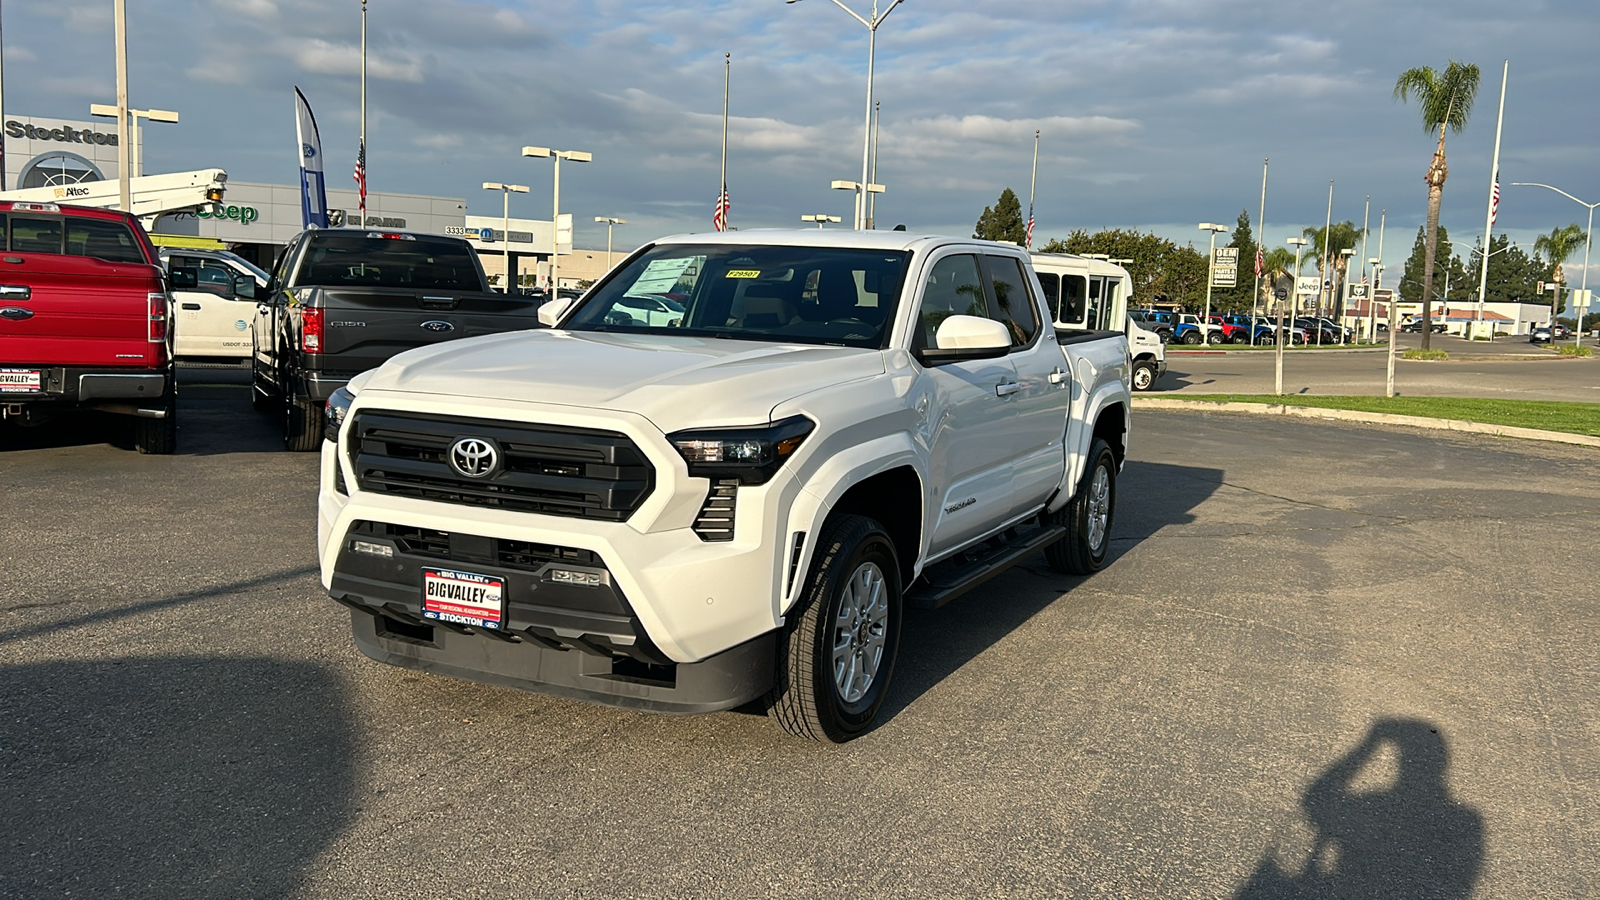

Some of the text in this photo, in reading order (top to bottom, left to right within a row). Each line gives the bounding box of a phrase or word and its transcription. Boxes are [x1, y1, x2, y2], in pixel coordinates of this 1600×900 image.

[5, 120, 119, 146] Stockton
[66, 187, 90, 197] Altec
[348, 215, 406, 228] RAM
[446, 227, 465, 236] 3333
[1216, 249, 1236, 257] OEM
[1299, 282, 1319, 292] Jeep
[441, 571, 484, 582] BIG VALLEY
[428, 581, 486, 603] BIGVALLEY
[440, 613, 483, 626] STOCKTON
